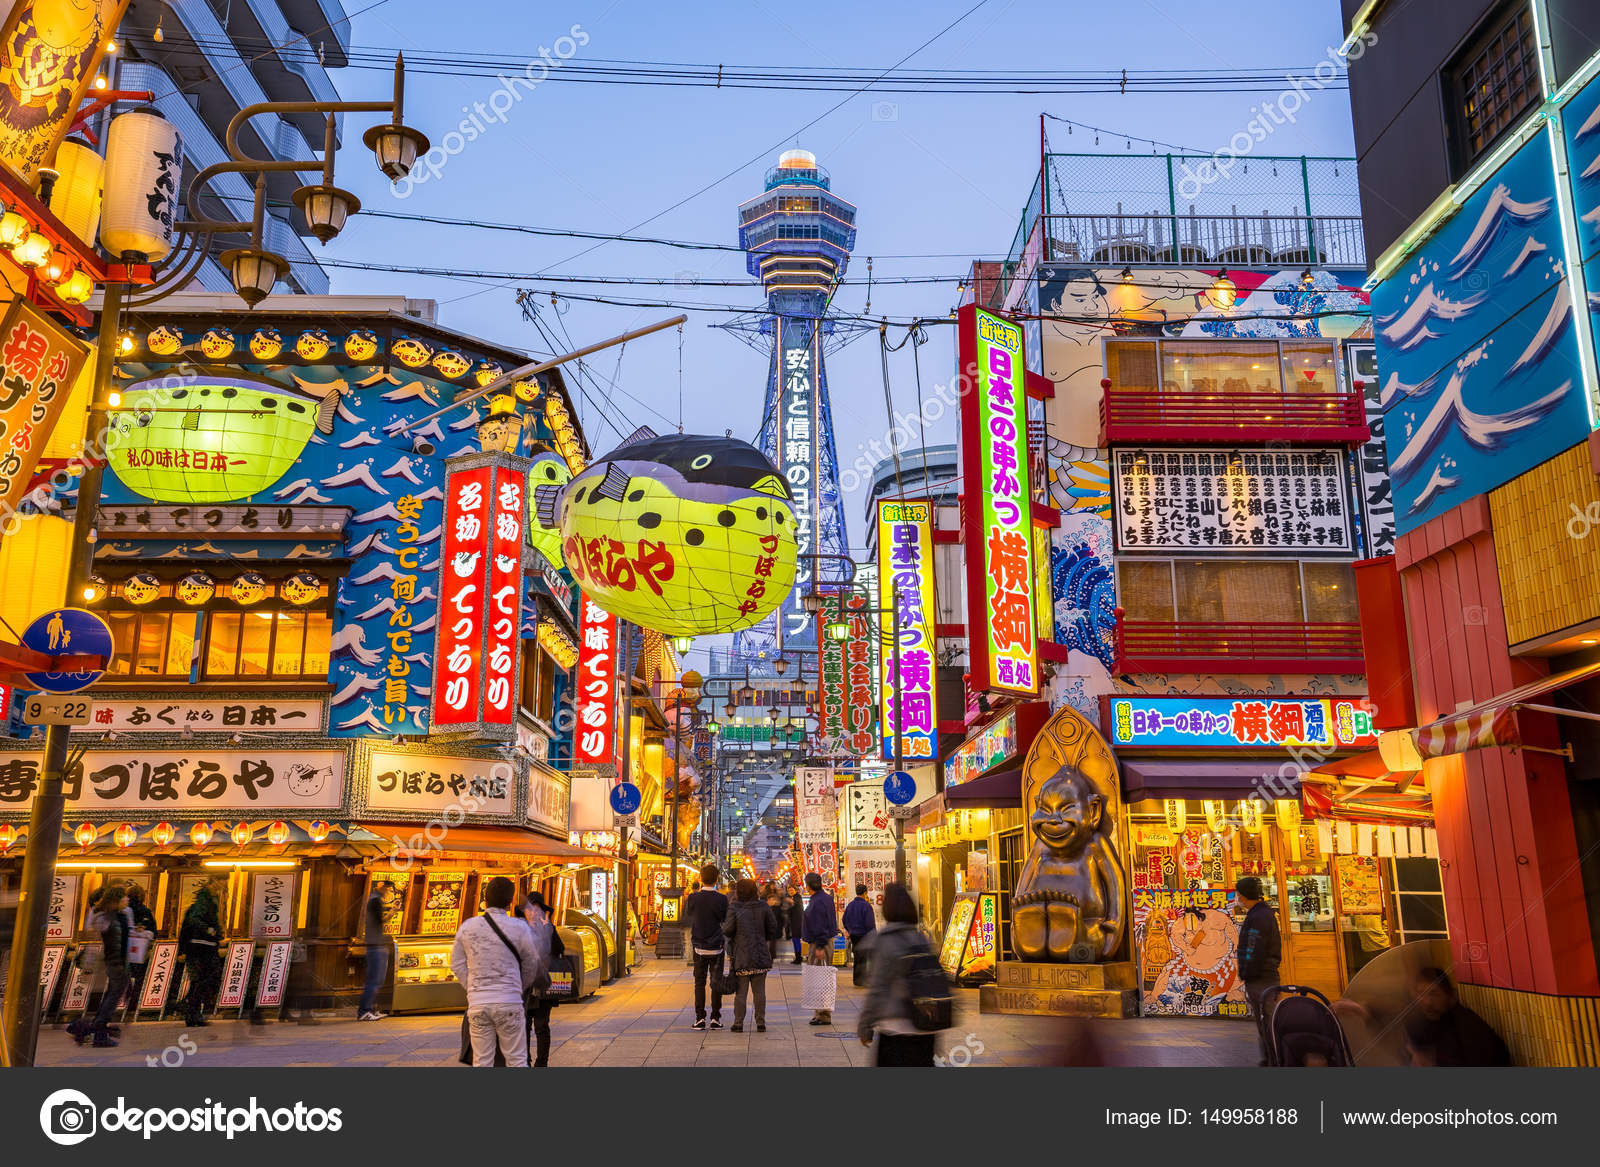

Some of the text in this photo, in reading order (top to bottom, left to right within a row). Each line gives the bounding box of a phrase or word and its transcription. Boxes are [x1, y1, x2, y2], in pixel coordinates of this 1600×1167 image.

[979, 316, 1020, 351] 新世界
[987, 347, 1019, 529] 日本一の串かつ
[127, 448, 247, 472] 私の味は日本一
[1229, 454, 1243, 476] 頭
[456, 482, 483, 541] 名物
[496, 483, 521, 541] 名物
[881, 505, 928, 522] 新世界
[738, 533, 782, 618] づぼらや
[891, 523, 924, 647] 日本一の串かつ
[988, 528, 1033, 656] 横綱
[384, 494, 423, 724] 安うて何んでも旨い
[886, 649, 931, 734] 横綱
[997, 656, 1032, 689] 酒処
[1117, 703, 1131, 741] 新世界
[1132, 711, 1230, 736] 日本一の串かつ
[1232, 703, 1305, 742] 横綱
[1304, 703, 1326, 743] 酒処
[1337, 704, 1354, 743] 新世界
[377, 770, 507, 800] づぼらや本店
[854, 860, 912, 870] 元祖串カツ専店
[1136, 890, 1229, 909] 大阪新世界
[1008, 967, 1092, 985] BILLIKEN
[1218, 1003, 1247, 1015] 新世界
